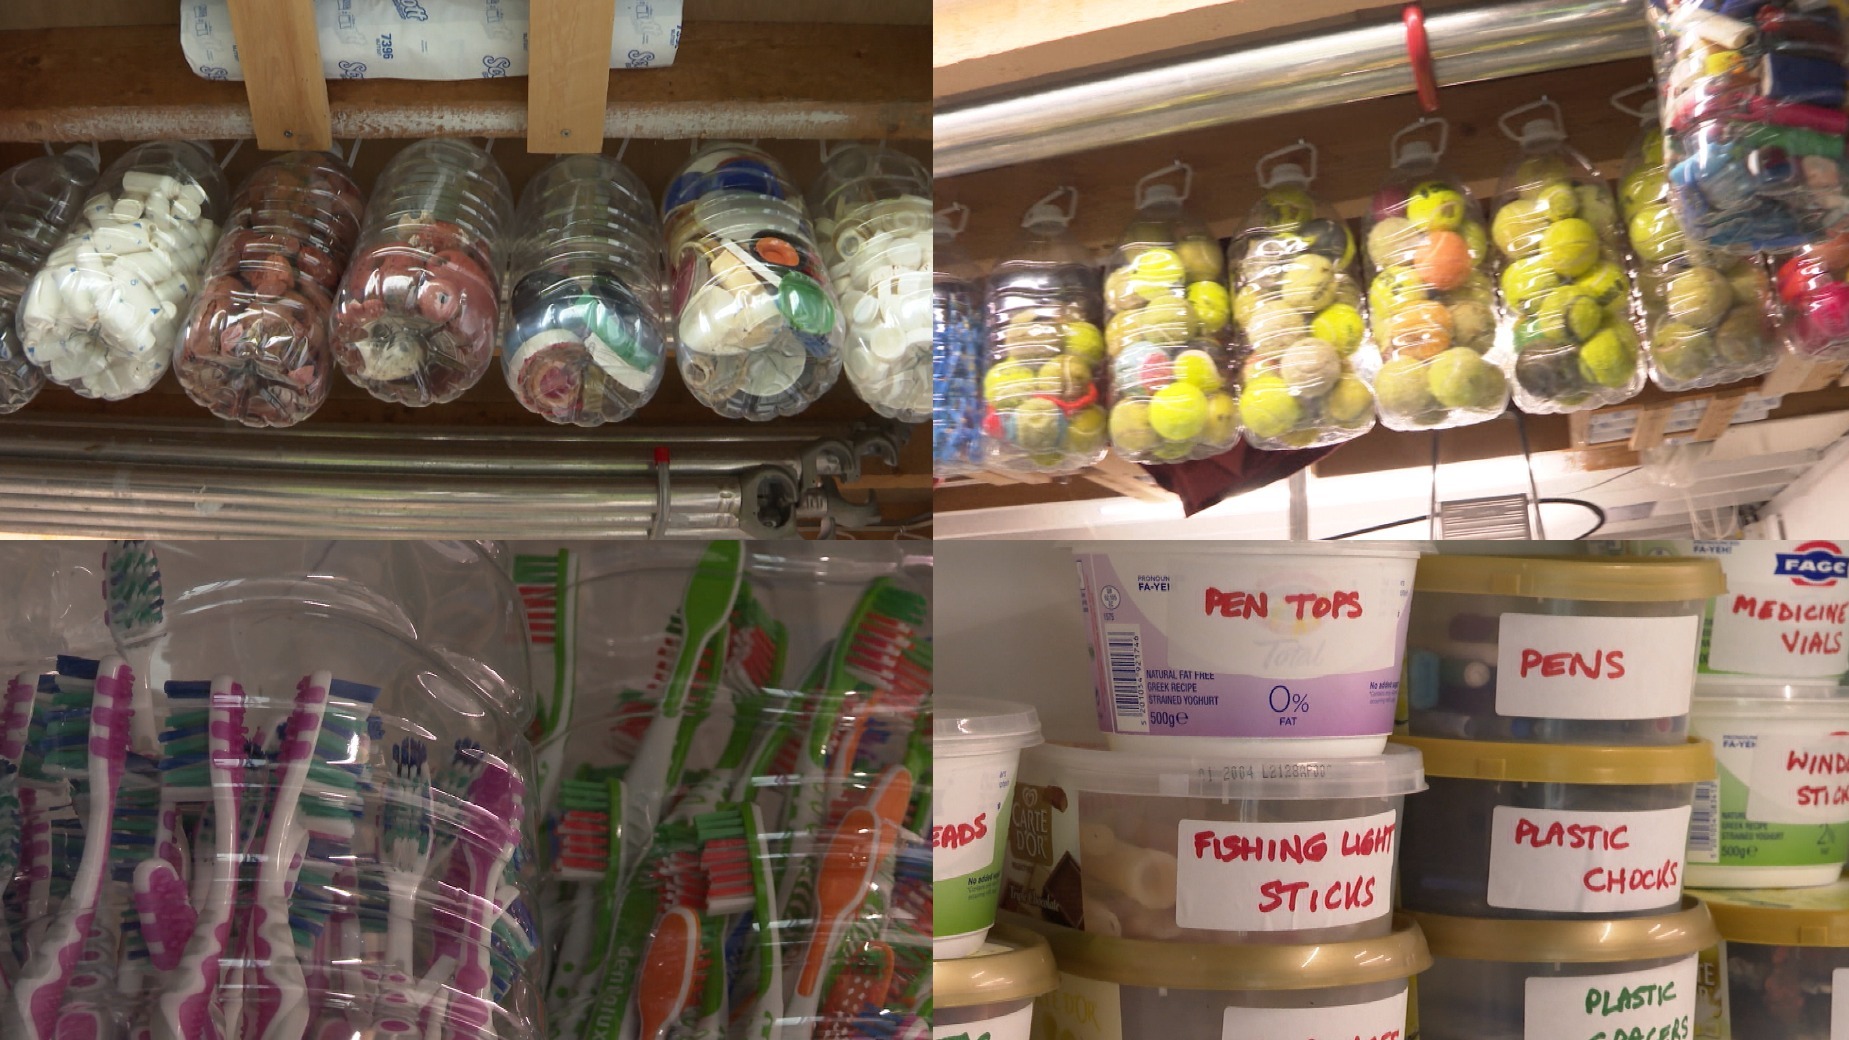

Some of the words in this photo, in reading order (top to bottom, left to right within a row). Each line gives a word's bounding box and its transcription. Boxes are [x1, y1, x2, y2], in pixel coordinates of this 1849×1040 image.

[381, 33, 393, 59] 7396
[1784, 558, 1846, 573] FAGE
[1205, 587, 1268, 618] PEN
[1285, 591, 1363, 619] TOPS
[1732, 594, 1849, 625] MEDICINE
[1781, 630, 1843, 655] VIALS
[1146, 669, 1177, 680] NATURAL
[1179, 670, 1192, 680] FAT
[1520, 648, 1625, 679] PENS
[1147, 682, 1170, 692] GREEK
[1171, 683, 1197, 692] RECIPE
[1148, 695, 1184, 705] STRAINED
[1184, 696, 1219, 706] YOGHURT
[1269, 685, 1309, 713] 0%
[1279, 716, 1297, 726] FAT
[1223, 766, 1253, 781] 2004
[1786, 750, 1849, 775] WIND
[1012, 802, 1048, 833] CARTE
[1016, 831, 1048, 859] D'OR
[1194, 830, 1328, 864] FISHING
[1341, 823, 1395, 856] LIGHT
[1515, 819, 1630, 849] PLASTIC
[1583, 859, 1678, 894] CHOCKS
[1259, 875, 1375, 913] STICKS
[1585, 981, 1676, 1016] PLASTIC
